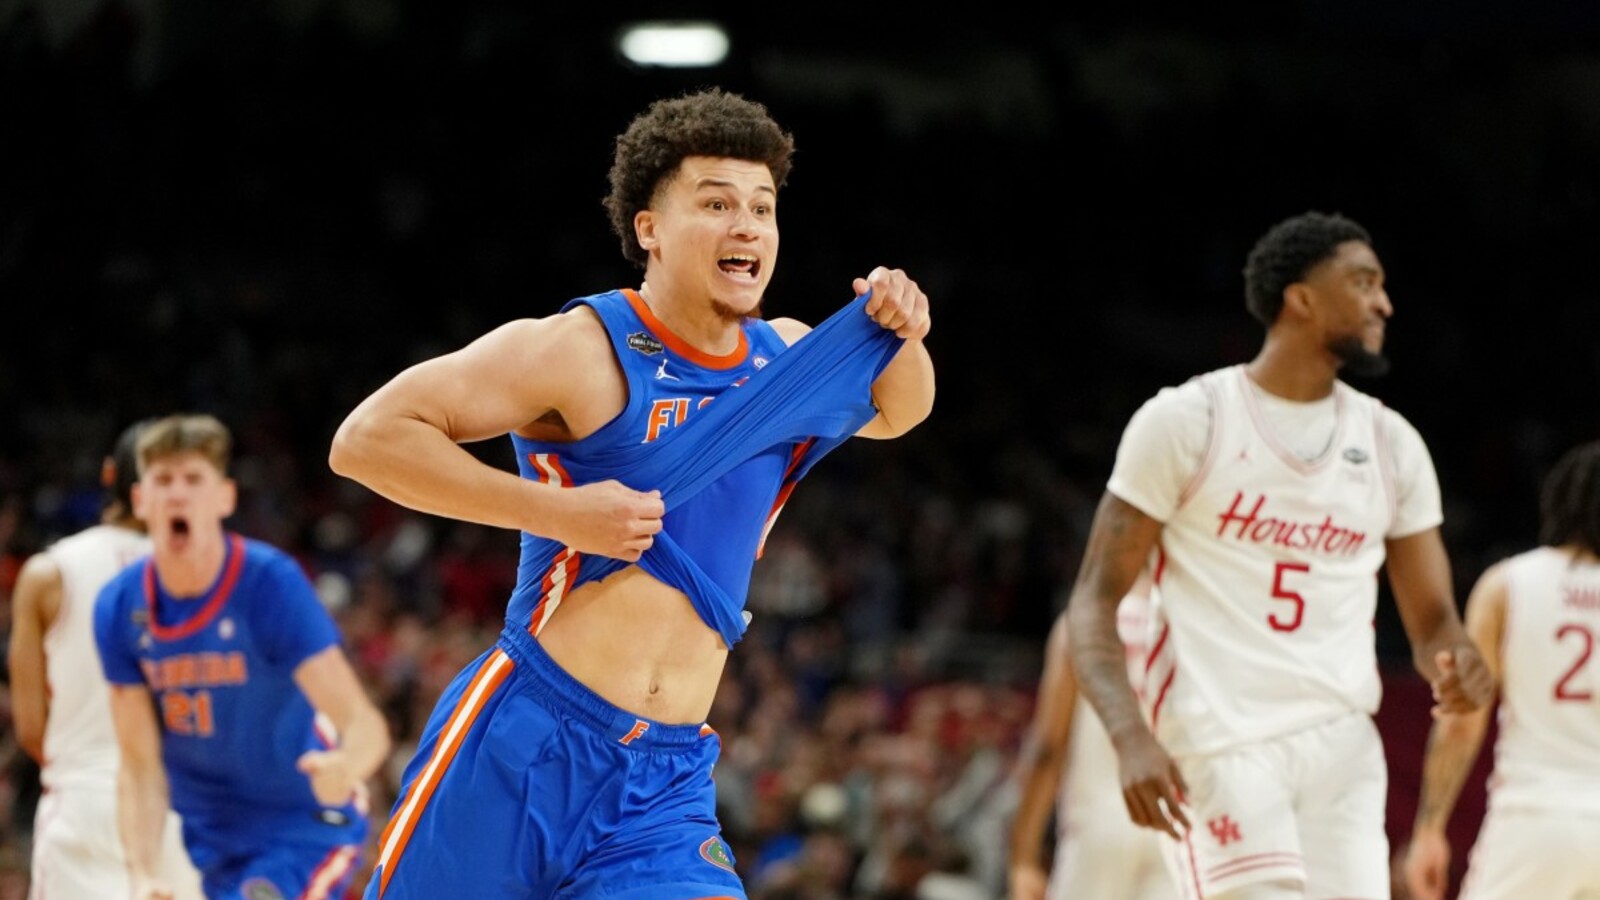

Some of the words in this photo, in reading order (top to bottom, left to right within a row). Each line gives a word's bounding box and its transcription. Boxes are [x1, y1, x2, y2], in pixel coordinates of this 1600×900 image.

[1217, 491, 1366, 556] Houston
[1267, 562, 1310, 633] 5
[162, 691, 214, 737] 21
[618, 719, 650, 745] F
